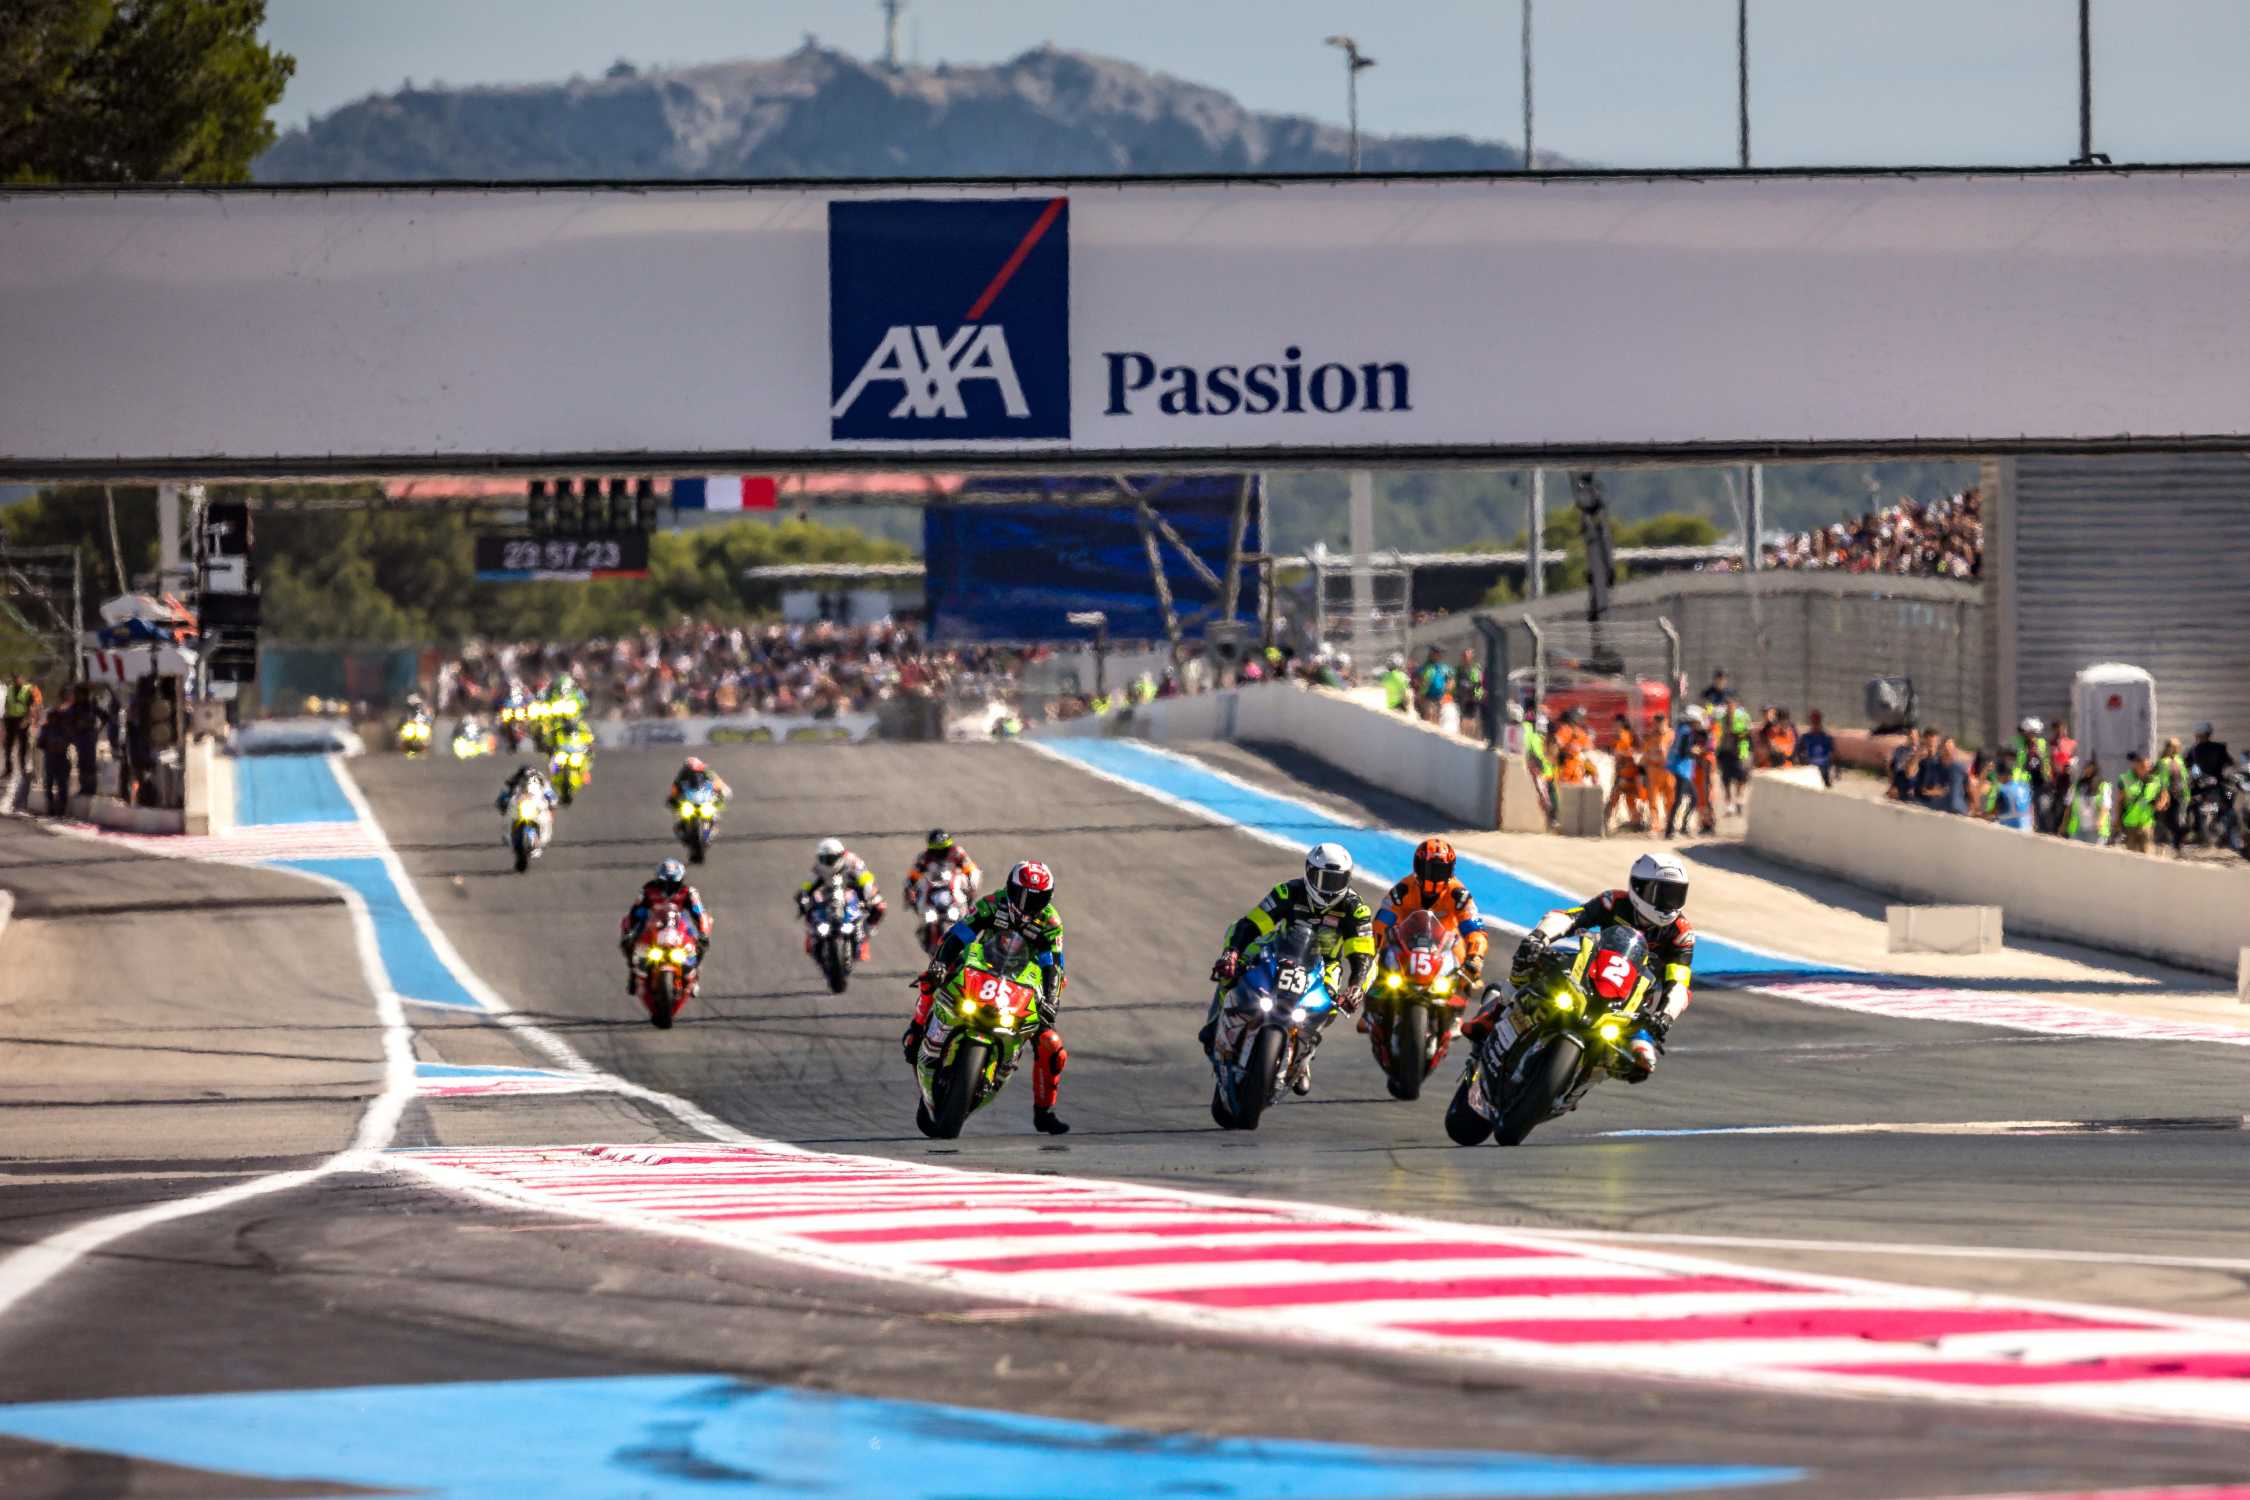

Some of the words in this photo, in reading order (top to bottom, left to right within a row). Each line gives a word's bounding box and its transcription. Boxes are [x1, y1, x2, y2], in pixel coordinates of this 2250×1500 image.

[832, 325, 1031, 419] AXA
[1103, 346, 1412, 416] Passion
[1278, 966, 1307, 994] 53
[1410, 953, 1433, 976] 15
[1601, 955, 1630, 988] 2
